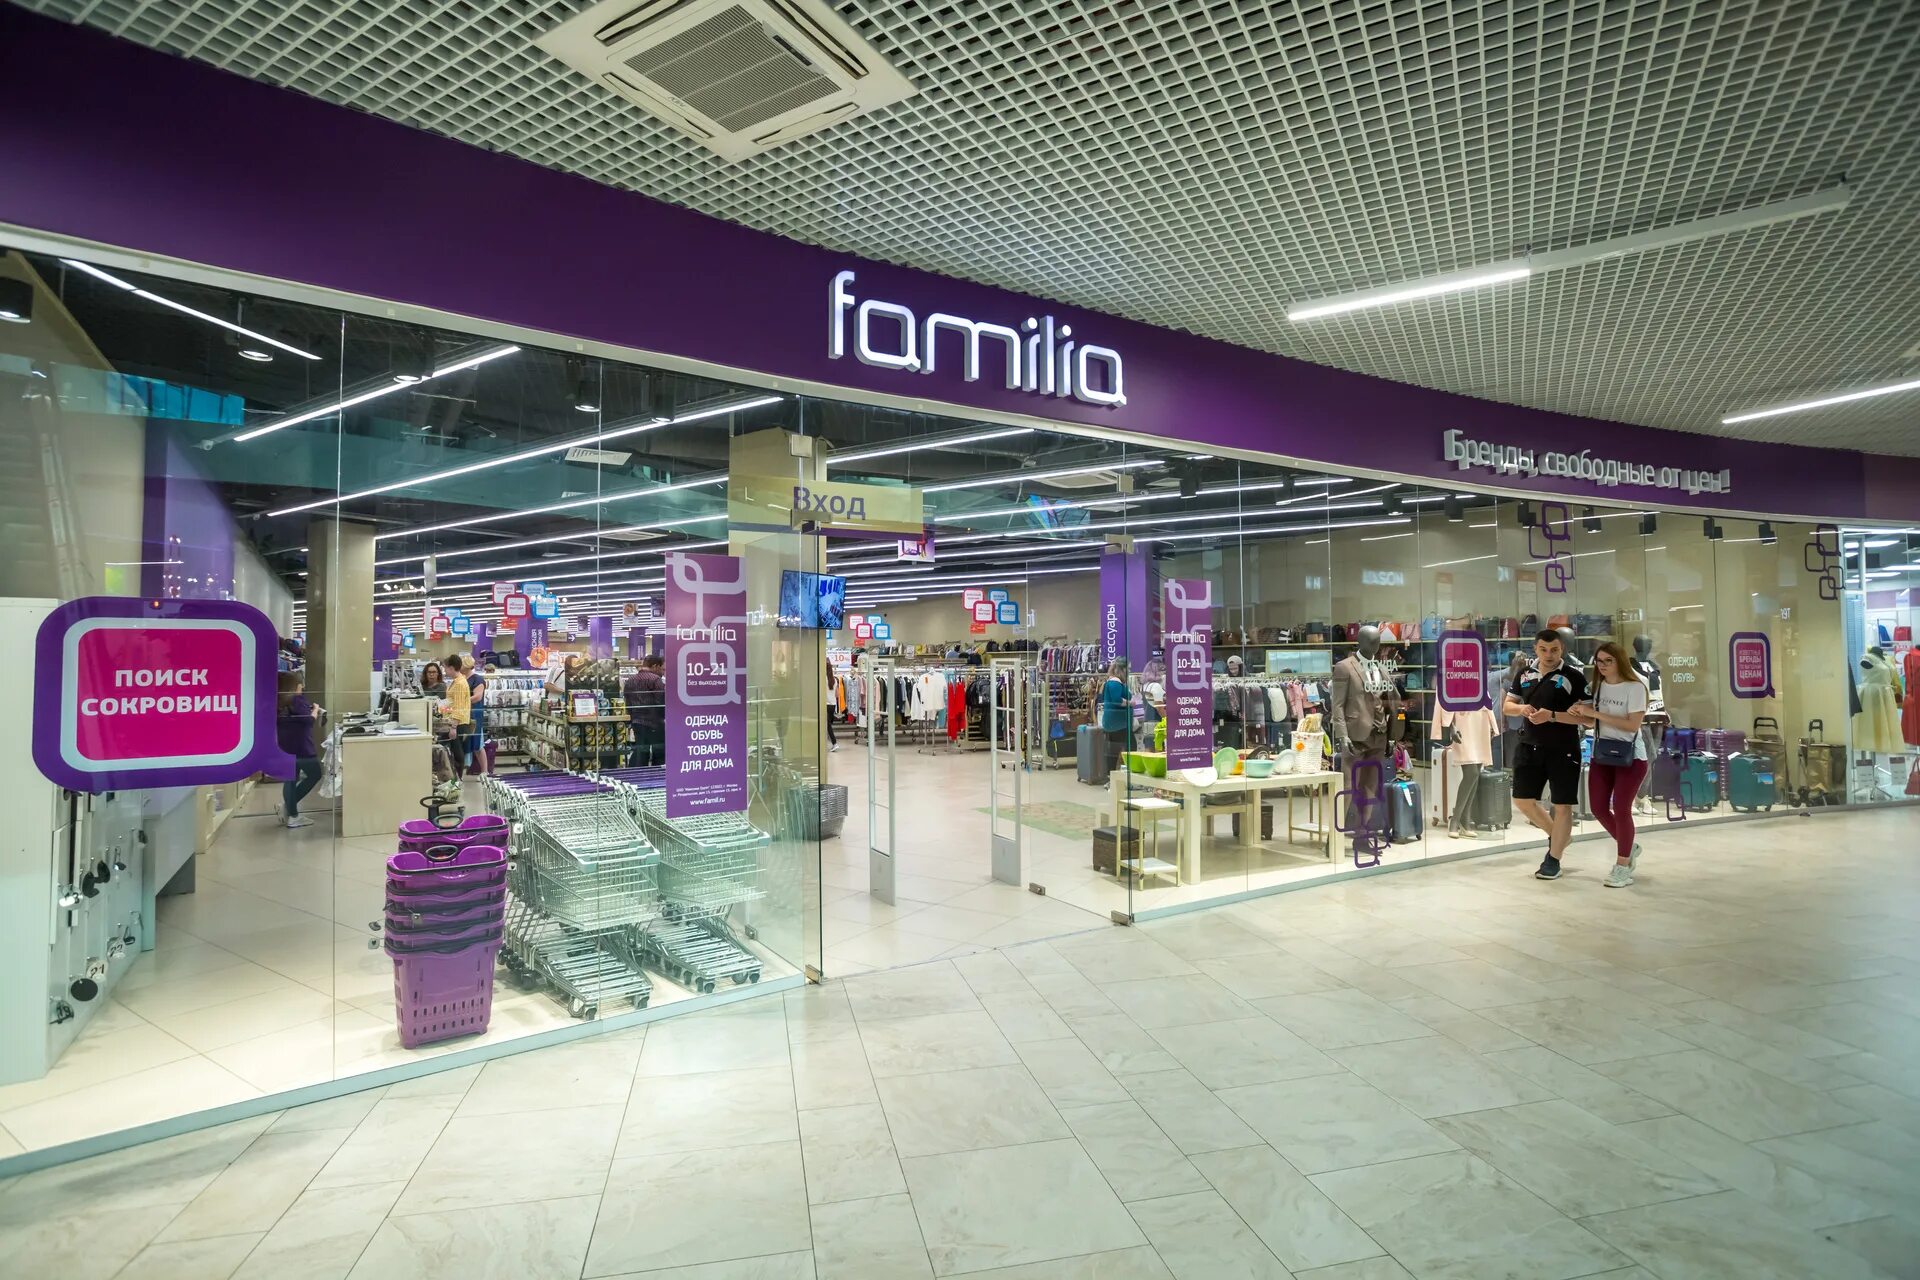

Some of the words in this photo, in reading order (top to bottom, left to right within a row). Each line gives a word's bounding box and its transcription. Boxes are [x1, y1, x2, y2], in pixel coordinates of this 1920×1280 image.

[828, 270, 1127, 408] familia
[1443, 429, 1539, 477] Бренды,
[1539, 449, 1655, 487] свободные
[1654, 467, 1681, 488] от
[1681, 469, 1730, 494] цен!
[793, 486, 866, 520] Вход
[676, 624, 737, 641] familia
[1107, 604, 1118, 664] ксессуары
[1170, 631, 1206, 643] familia
[1178, 658, 1201, 669] 10-21
[1452, 660, 1472, 668] ПОИСК
[1668, 656, 1699, 667] ОДЕЖДА
[1739, 656, 1762, 664] БРЕНДЫ
[687, 663, 727, 676] 10-21
[1740, 670, 1762, 679] ЦЕНАМ
[115, 668, 208, 688] ПОИСК
[1446, 672, 1480, 680] СОКРОВИЩ
[1672, 673, 1696, 683] ОБУВЬ
[81, 694, 238, 716] СОКРОВИЩ
[1176, 696, 1202, 706] ОДЕЖДА
[1180, 706, 1199, 716] ОБУВЬ
[685, 715, 728, 728] ОДЕЖДА
[1178, 718, 1202, 726] ТОВАРЫ
[691, 729, 724, 741] ОБУВЬ
[1174, 729, 1186, 738] ДЛЯ
[1188, 728, 1205, 737] ДОМА
[687, 744, 728, 756] ТОВАРЫ
[680, 760, 702, 773] ДЛЯ
[704, 757, 734, 770] ДОМА
[690, 797, 726, 806] www.famil.ru
